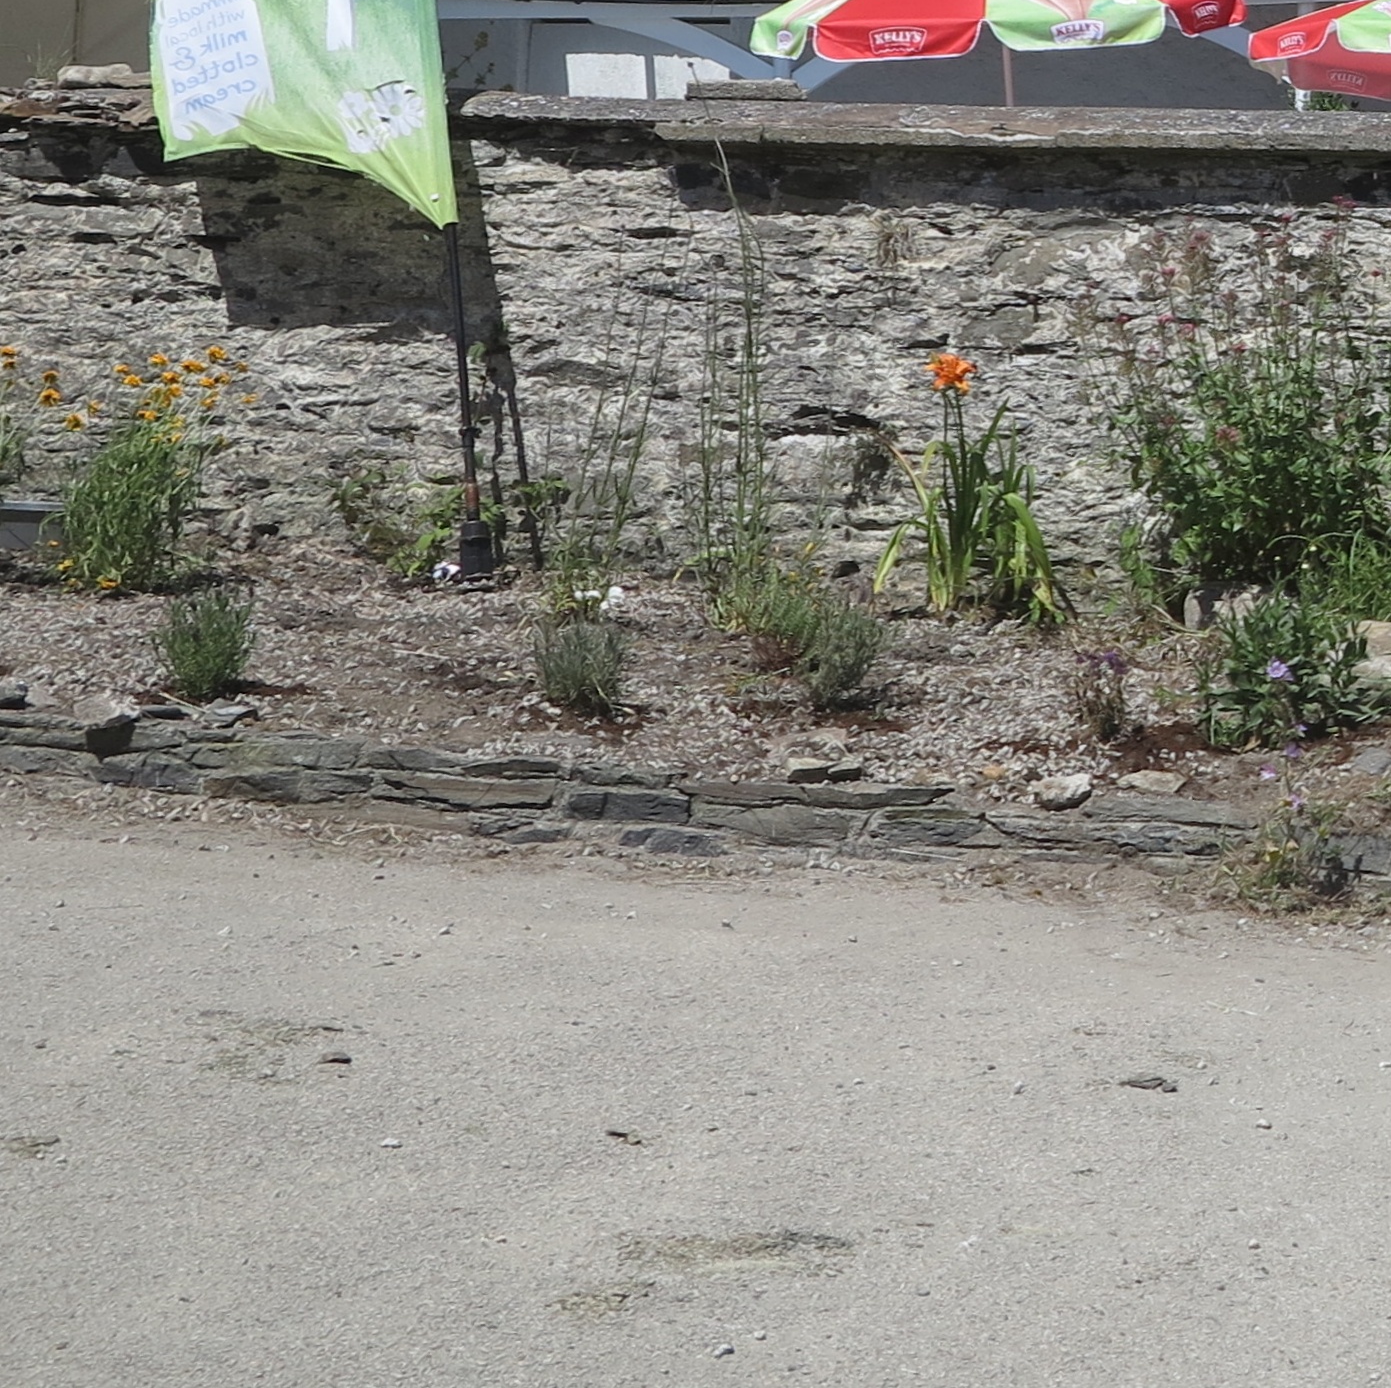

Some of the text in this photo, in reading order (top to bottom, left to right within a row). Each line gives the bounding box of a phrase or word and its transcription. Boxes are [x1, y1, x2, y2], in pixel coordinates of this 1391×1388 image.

[1055, 22, 1101, 36] KELLY'S
[873, 31, 922, 45] KELLY'S
[1279, 35, 1304, 49] KELLY'S
